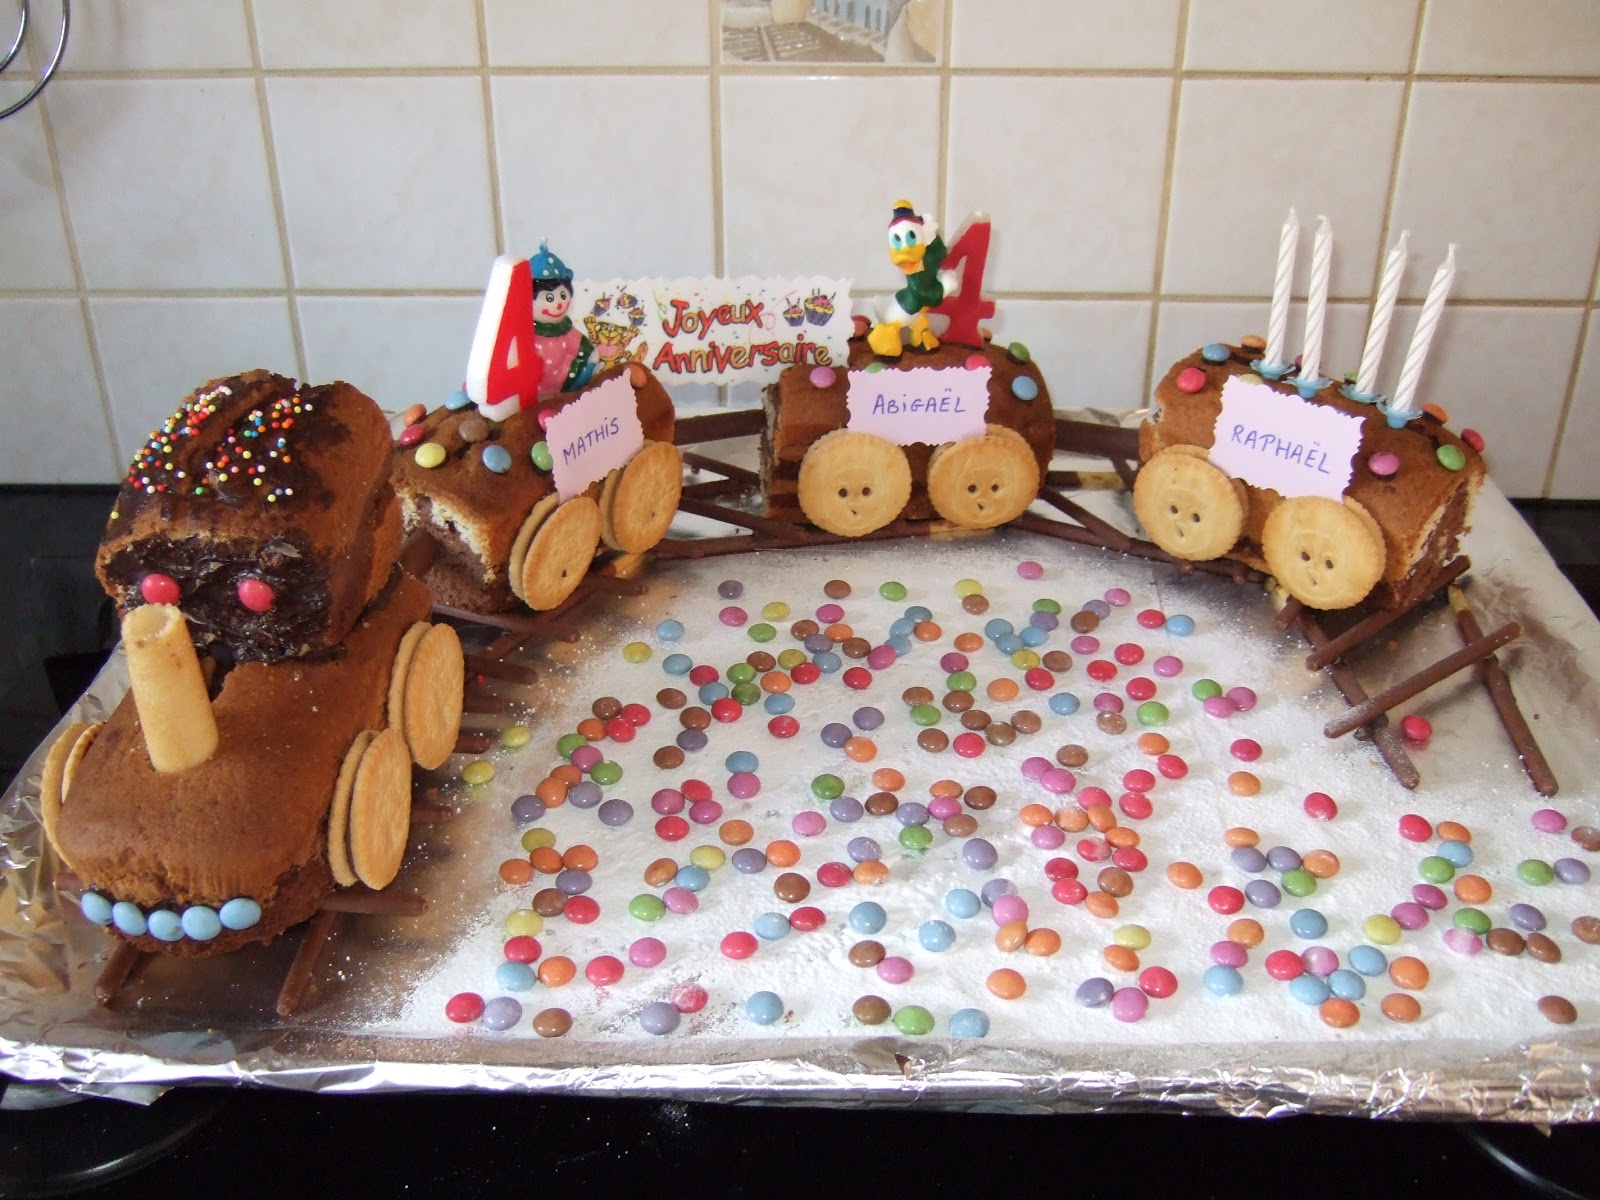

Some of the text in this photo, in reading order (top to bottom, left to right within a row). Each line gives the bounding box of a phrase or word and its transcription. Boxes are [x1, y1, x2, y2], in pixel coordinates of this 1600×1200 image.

[927, 213, 996, 348] 4
[470, 255, 545, 416] 4
[661, 298, 765, 341] Joyeux
[652, 333, 833, 374] Anniversaire
[1230, 423, 1331, 475] RAPHAËL
